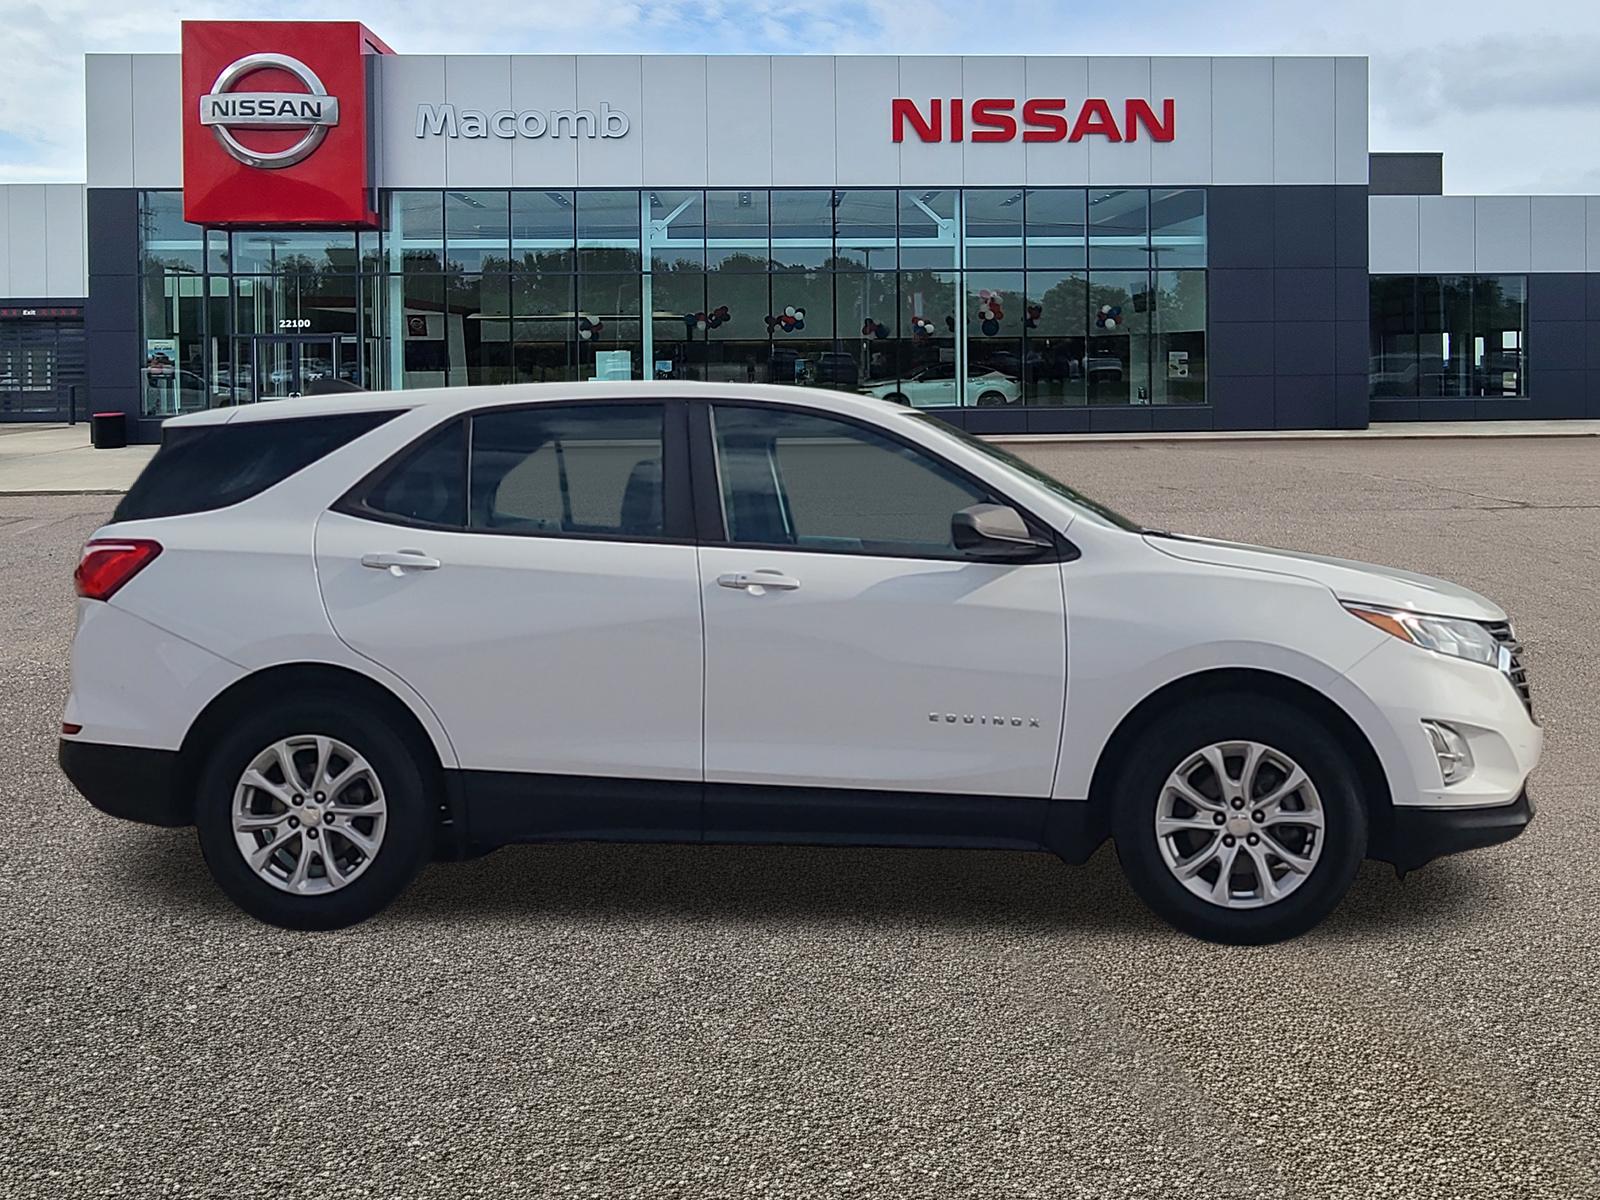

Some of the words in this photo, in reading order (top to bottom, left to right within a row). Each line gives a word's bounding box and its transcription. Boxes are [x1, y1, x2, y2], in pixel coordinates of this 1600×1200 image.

[211, 100, 322, 118] NISSAN
[415, 102, 630, 138] Macomb
[892, 98, 1175, 143] NISSAN
[279, 319, 311, 328] 22100
[928, 711, 1041, 728] EQUINOX
